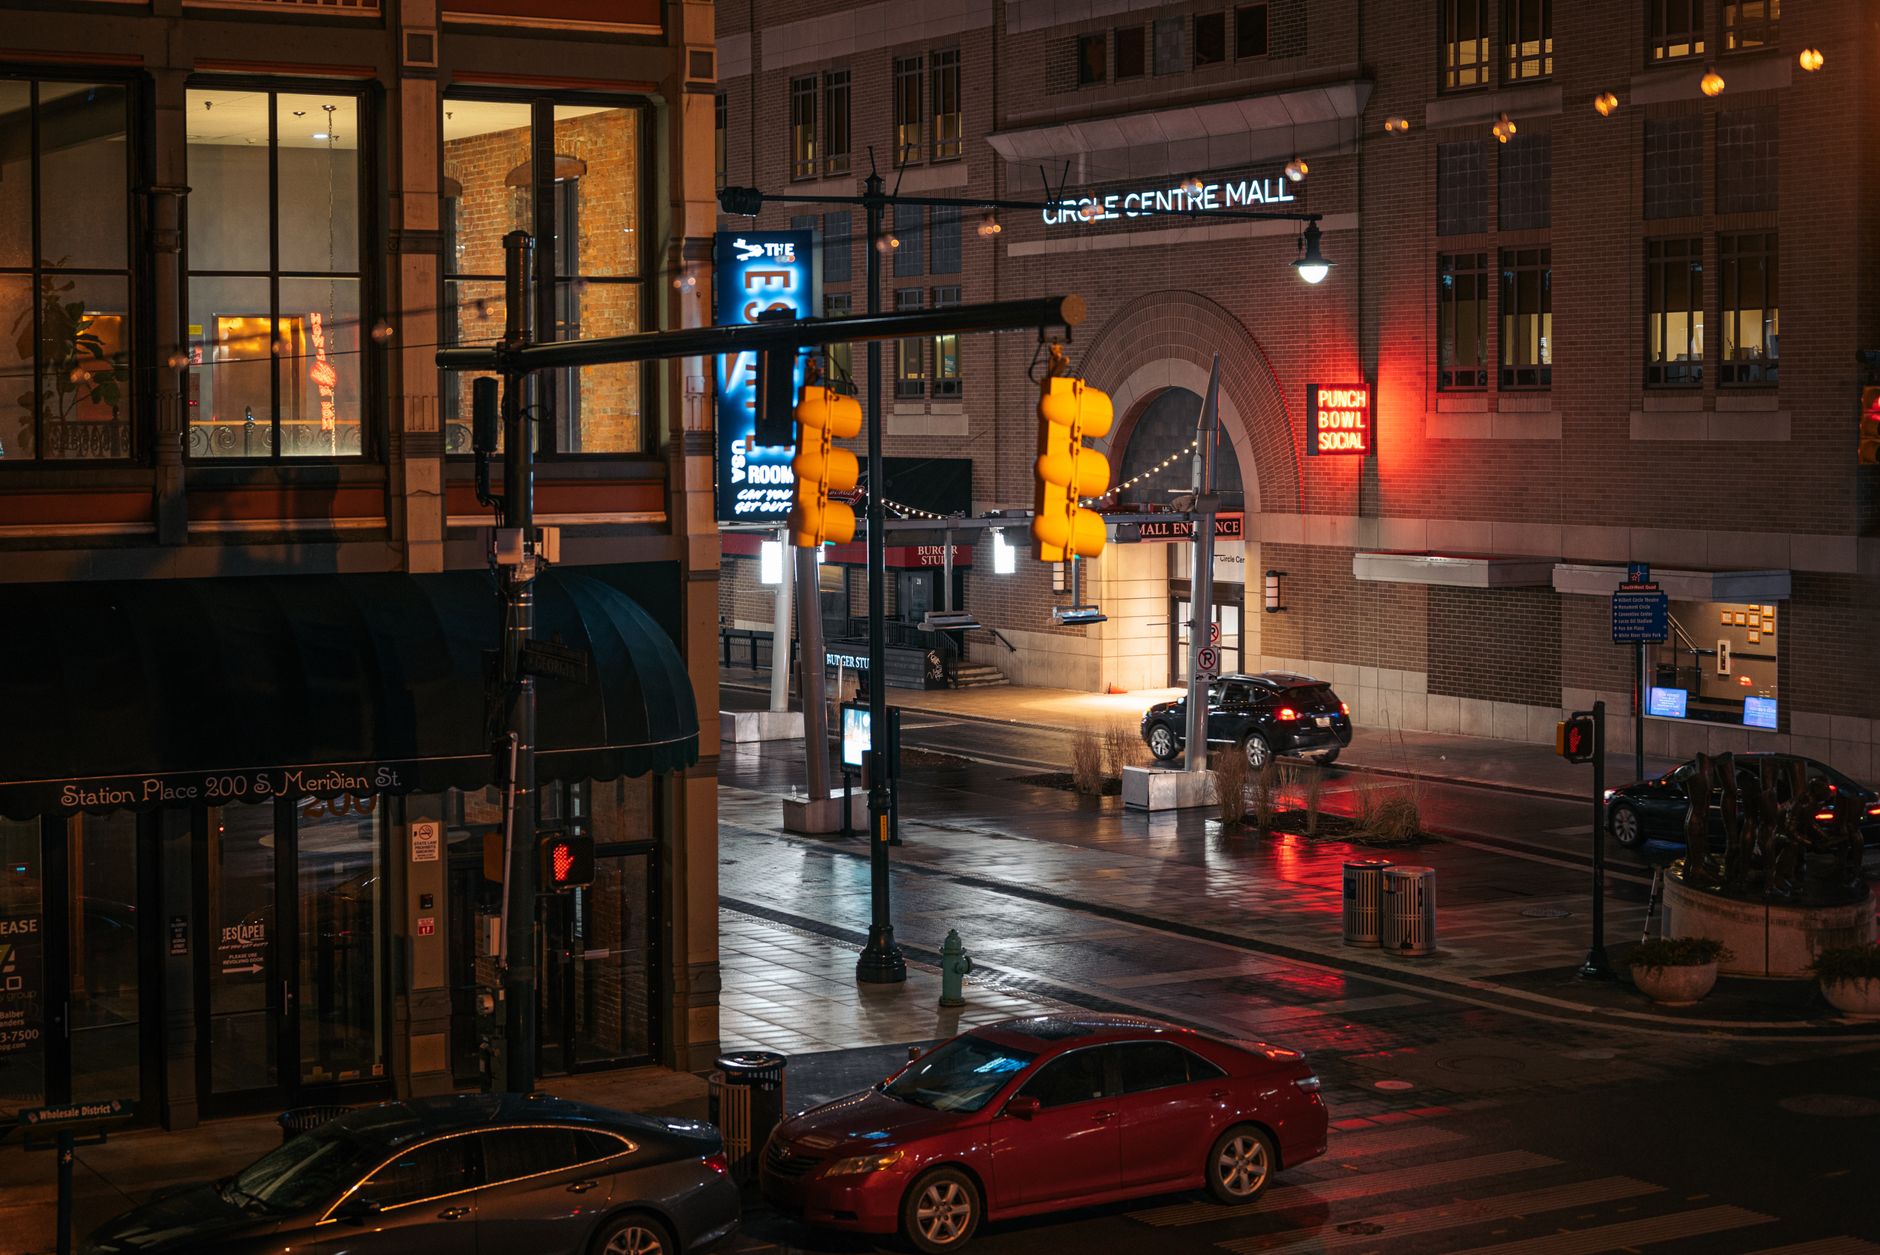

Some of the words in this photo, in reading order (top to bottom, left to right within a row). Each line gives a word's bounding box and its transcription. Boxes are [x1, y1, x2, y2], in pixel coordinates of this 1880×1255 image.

[1043, 195, 1119, 224] CIRCLE
[1125, 184, 1219, 217] CENTRE
[1225, 177, 1294, 207] MALL
[764, 243, 794, 257] THE
[1318, 390, 1366, 408] PUNCH
[1318, 410, 1366, 428] BOWL
[1318, 431, 1366, 450] SOCIAL
[731, 439, 746, 483] USA
[748, 465, 794, 484] ROOM
[737, 489, 766, 501] CAN
[766, 489, 794, 501] YOU
[734, 501, 761, 515] GET
[1139, 522, 1169, 535] MALL
[1173, 521, 1240, 534] ENTNCE
[918, 545, 958, 555] BURGR
[826, 653, 854, 667] BURGER
[61, 785, 136, 807] Station
[142, 778, 198, 801] Place
[205, 775, 247, 798] 200
[253, 773, 275, 794] S.
[275, 769, 369, 797] Meridian
[375, 767, 402, 788] St.
[40, 1107, 79, 1120] Wholesale
[81, 1104, 112, 1116] District
